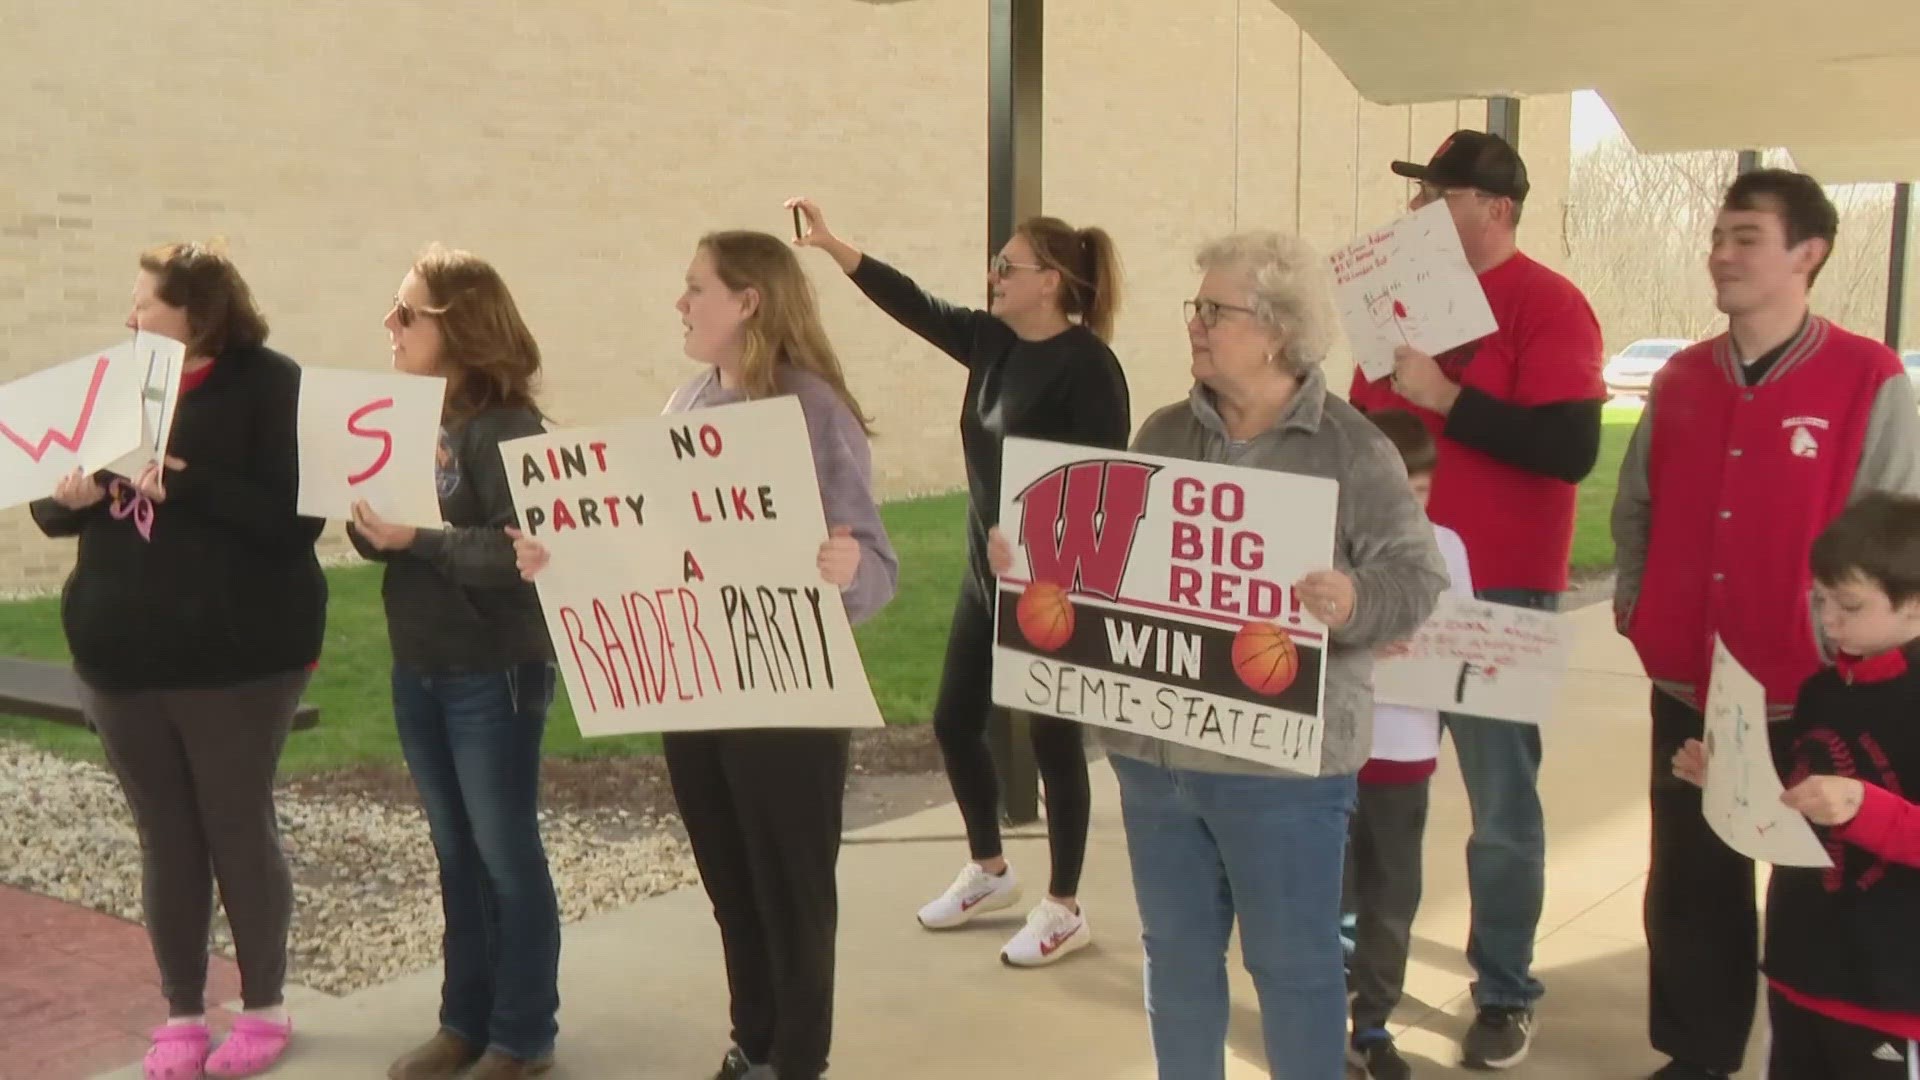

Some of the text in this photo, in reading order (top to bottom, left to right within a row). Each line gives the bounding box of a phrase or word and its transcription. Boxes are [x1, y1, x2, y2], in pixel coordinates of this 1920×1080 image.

[0, 356, 110, 462] W
[347, 398, 394, 486] S
[522, 424, 723, 486] AINT NO
[525, 485, 777, 536] PARTY LIKE
[1172, 476, 1245, 523] GO
[1012, 459, 1166, 603] W
[1170, 521, 1265, 571] BIG
[683, 550, 705, 582] A
[1169, 565, 1302, 625] RED!
[559, 584, 834, 713] RAIDER PARTY
[1104, 616, 1203, 681] WIN
